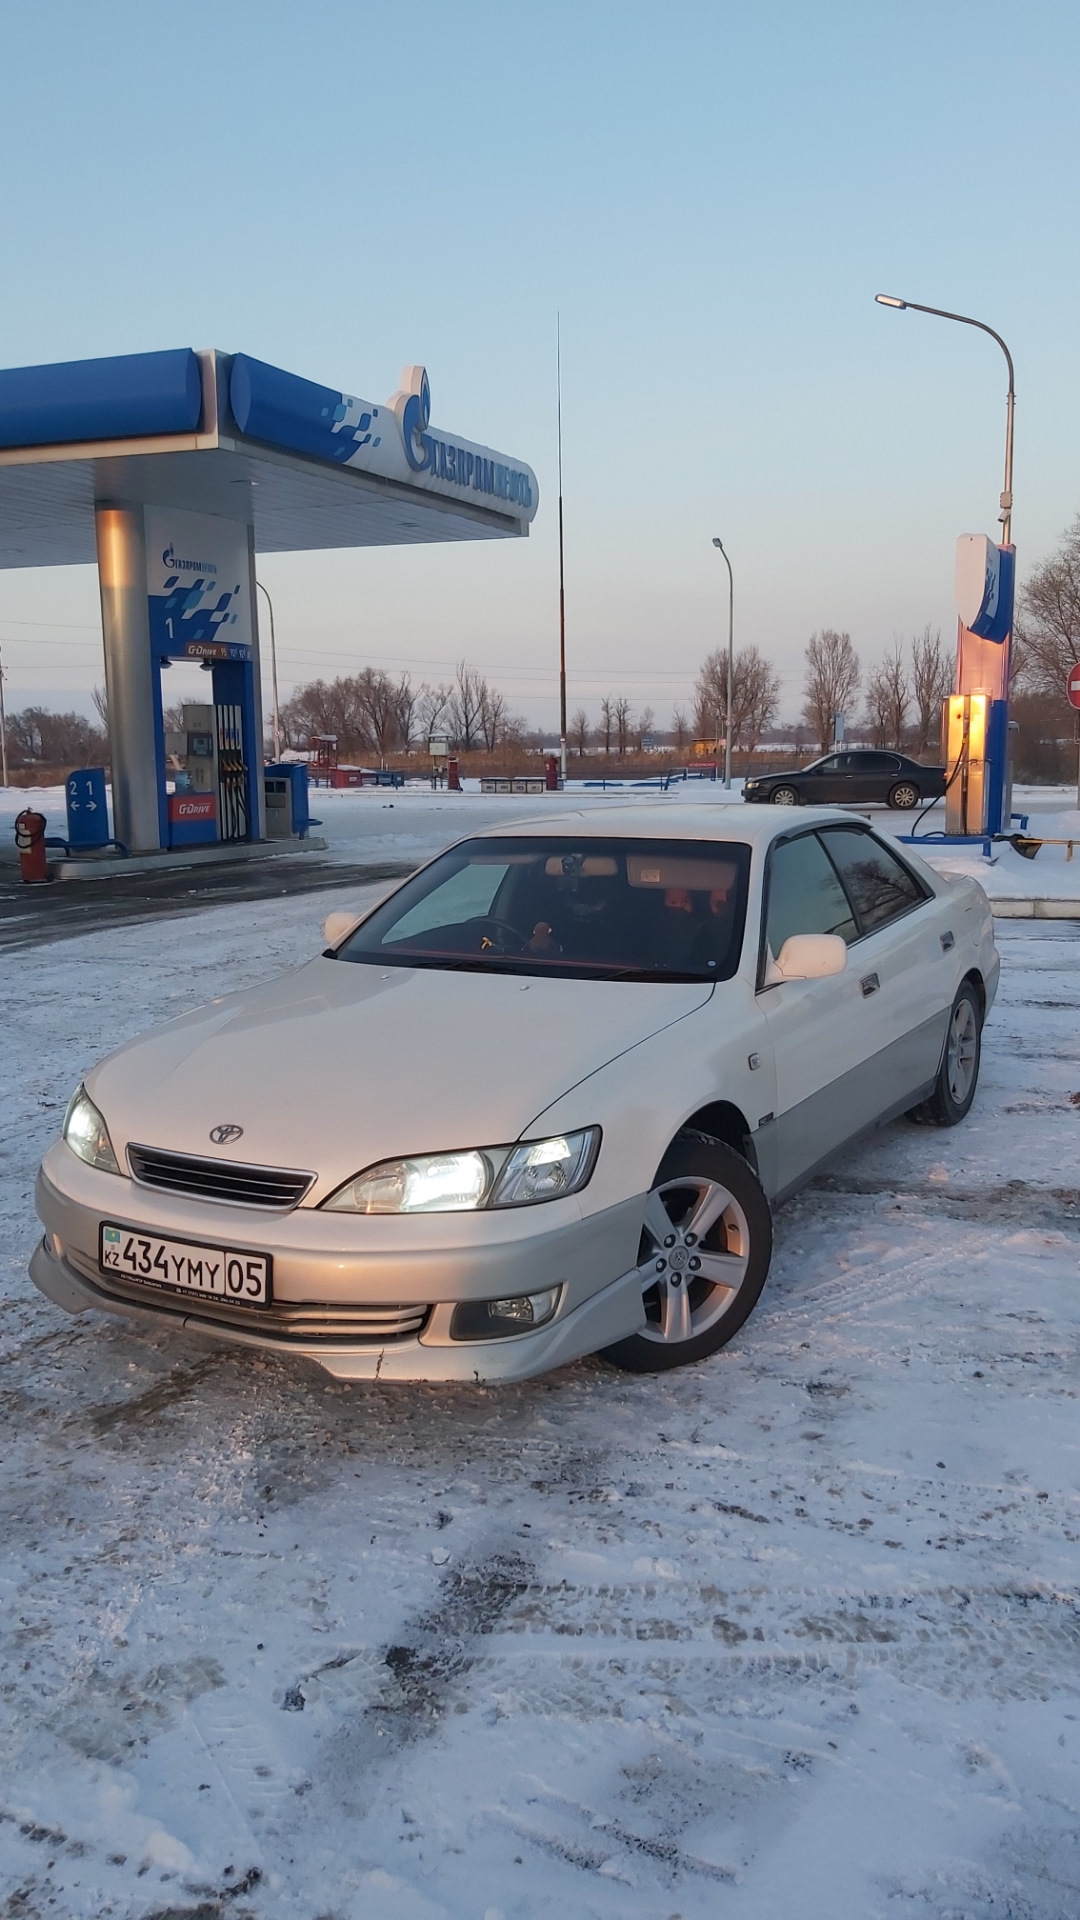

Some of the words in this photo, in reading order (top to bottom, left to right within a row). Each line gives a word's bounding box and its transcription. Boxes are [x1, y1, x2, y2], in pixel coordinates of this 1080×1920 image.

[431, 438, 533, 508] ГАЗПРОМНЕФТЬ
[165, 617, 174, 639] 1
[69, 780, 78, 796] 2
[86, 780, 93, 796] 1
[104, 1249, 120, 1267] KZ
[227, 1259, 263, 1297] 05
